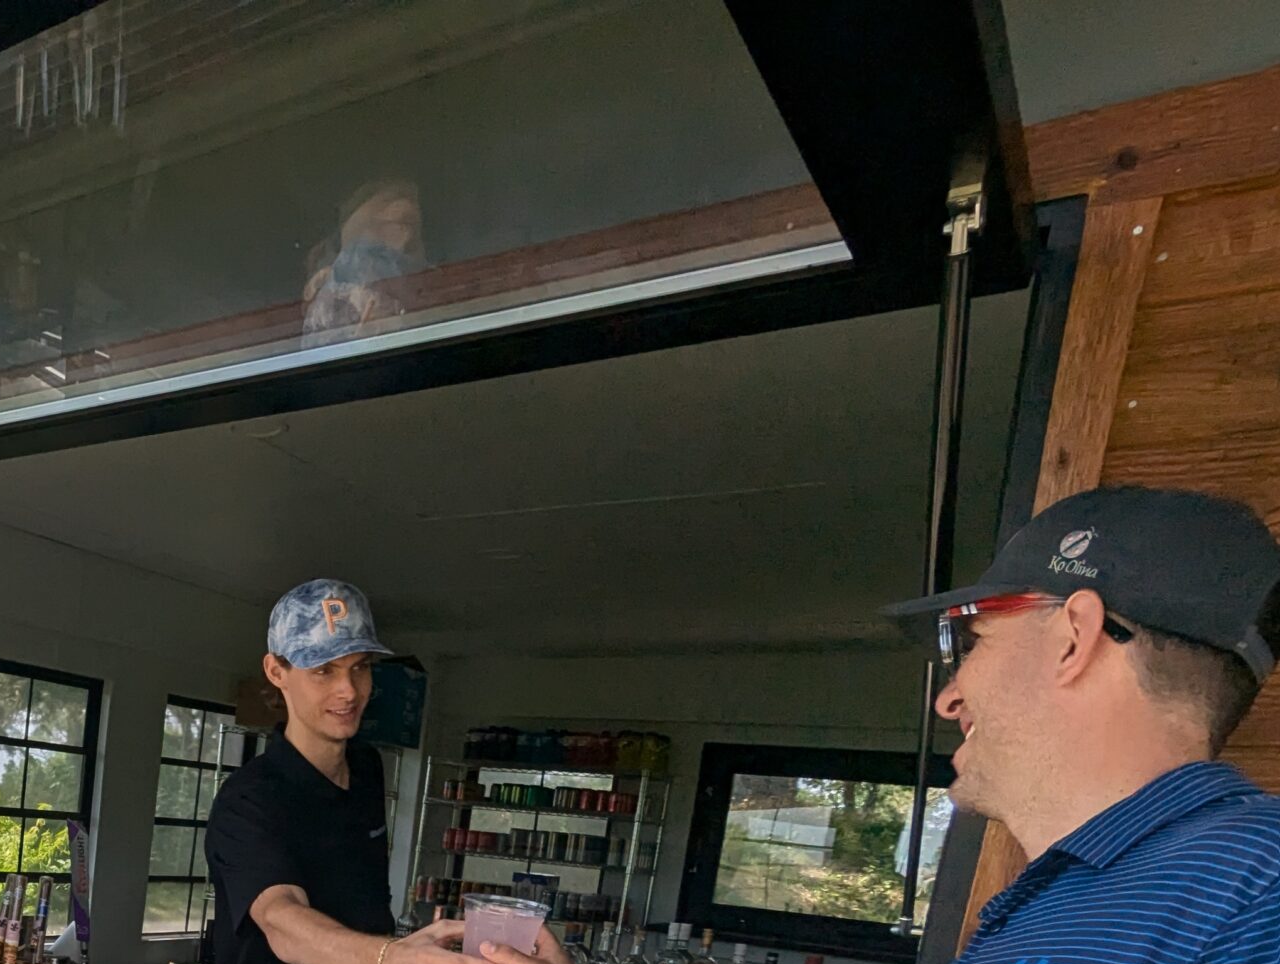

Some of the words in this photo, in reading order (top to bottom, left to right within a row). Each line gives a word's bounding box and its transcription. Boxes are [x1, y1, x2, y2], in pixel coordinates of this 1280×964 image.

[1048, 556, 1064, 574] Ko
[1066, 559, 1098, 578] Olina
[322, 598, 348, 635] P
